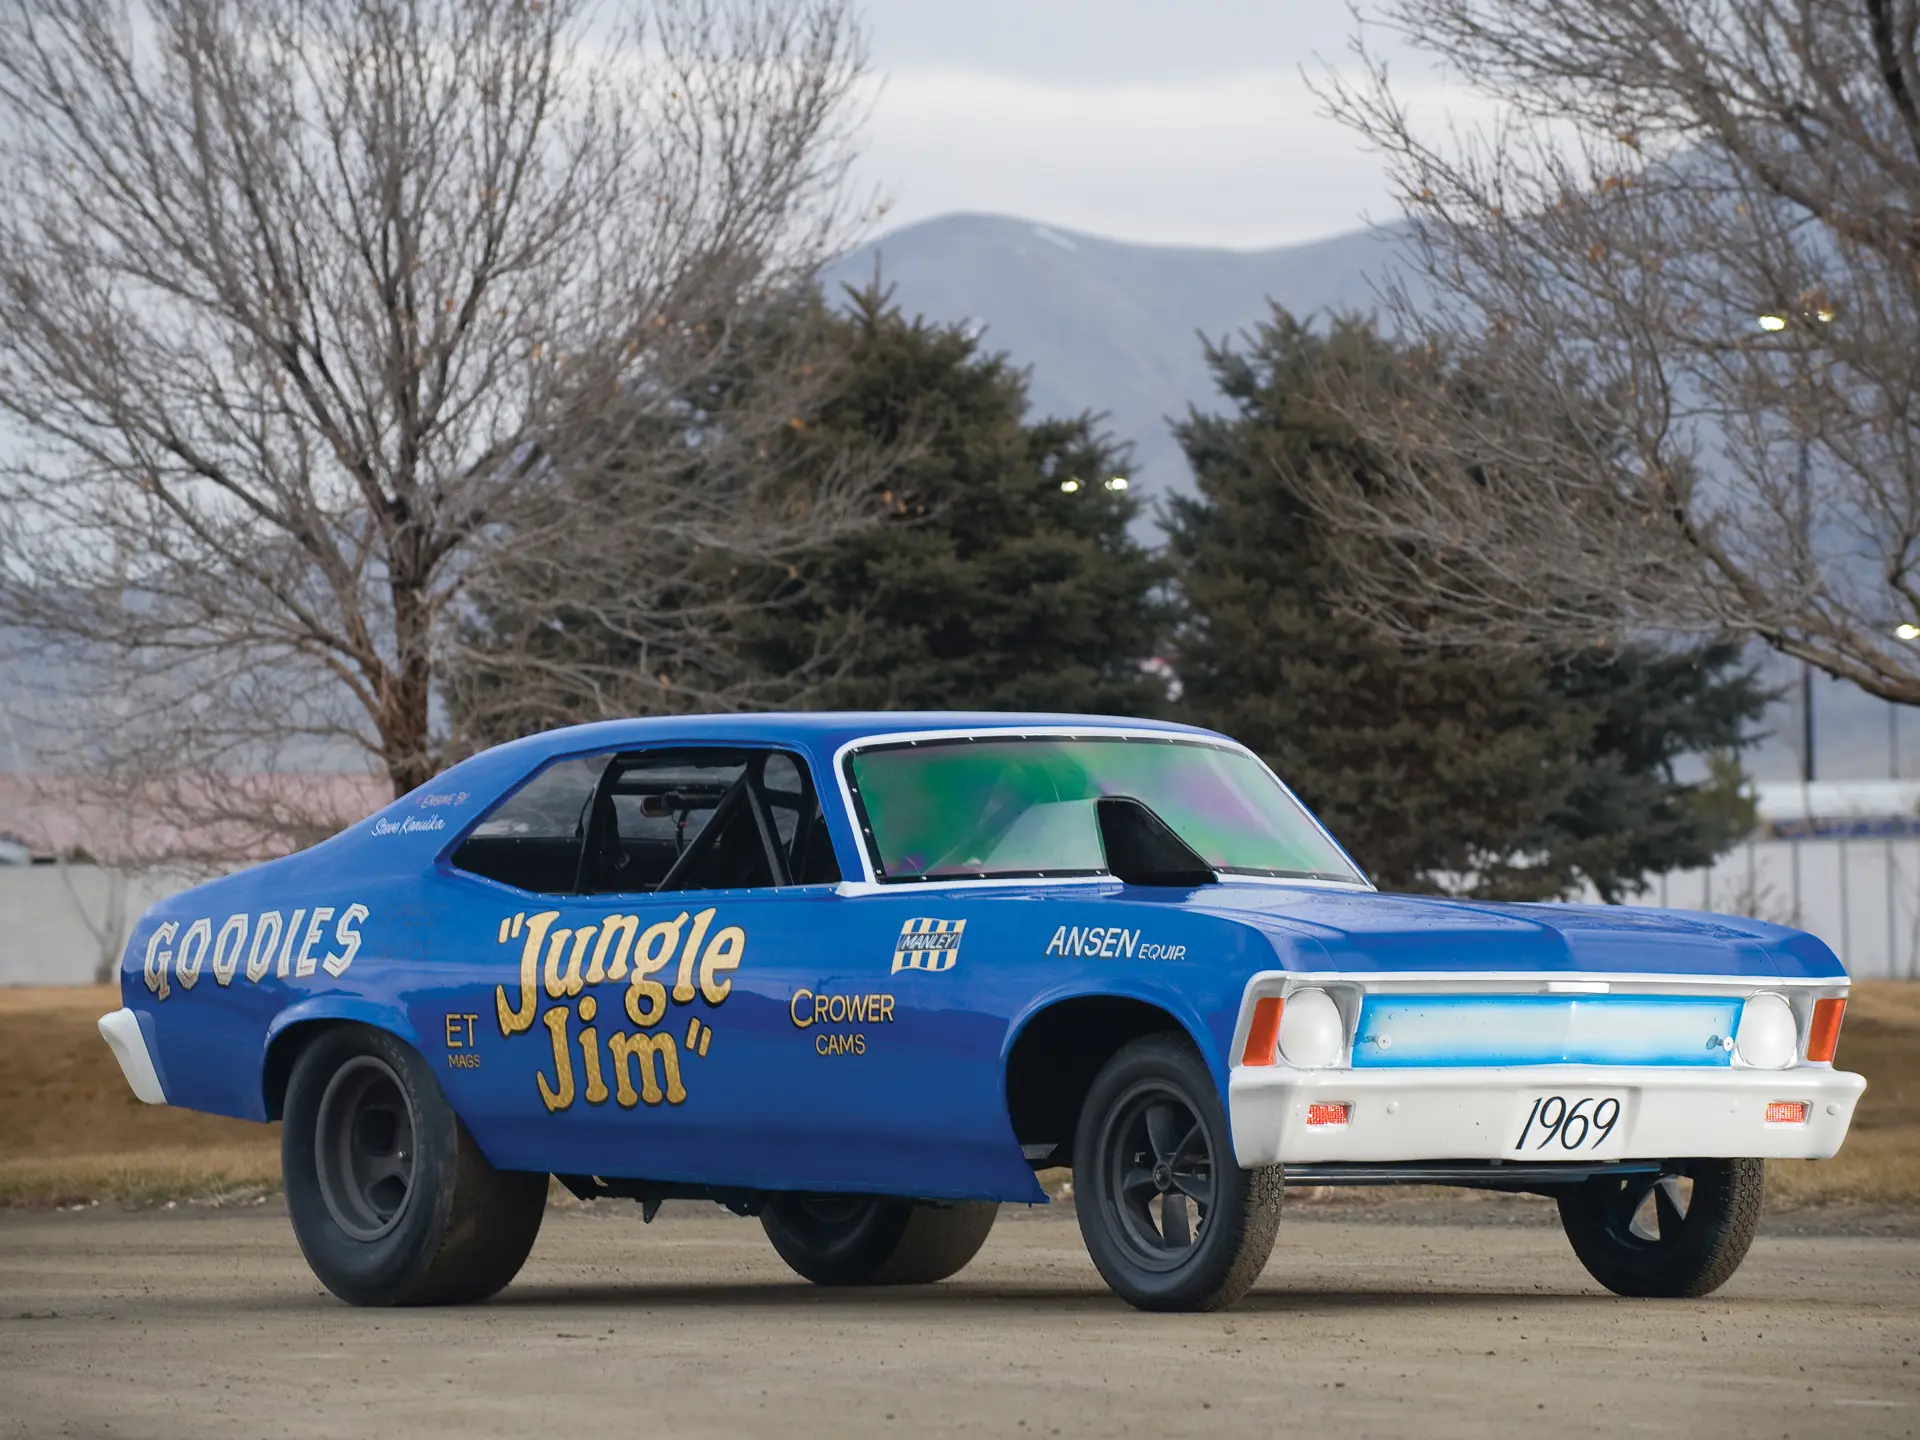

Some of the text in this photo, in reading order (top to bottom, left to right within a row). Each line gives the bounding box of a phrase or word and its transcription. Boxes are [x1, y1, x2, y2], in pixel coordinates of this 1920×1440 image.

[143, 902, 370, 1002] GOODIES
[901, 933, 955, 950] MANLEY
[1045, 925, 1141, 959] ANSEN
[790, 988, 895, 1029] CROWER
[446, 1013, 479, 1048] ET
[815, 1034, 866, 1056] CAMS
[448, 1053, 481, 1069] MAGS
[1515, 1095, 1620, 1150] 1969
